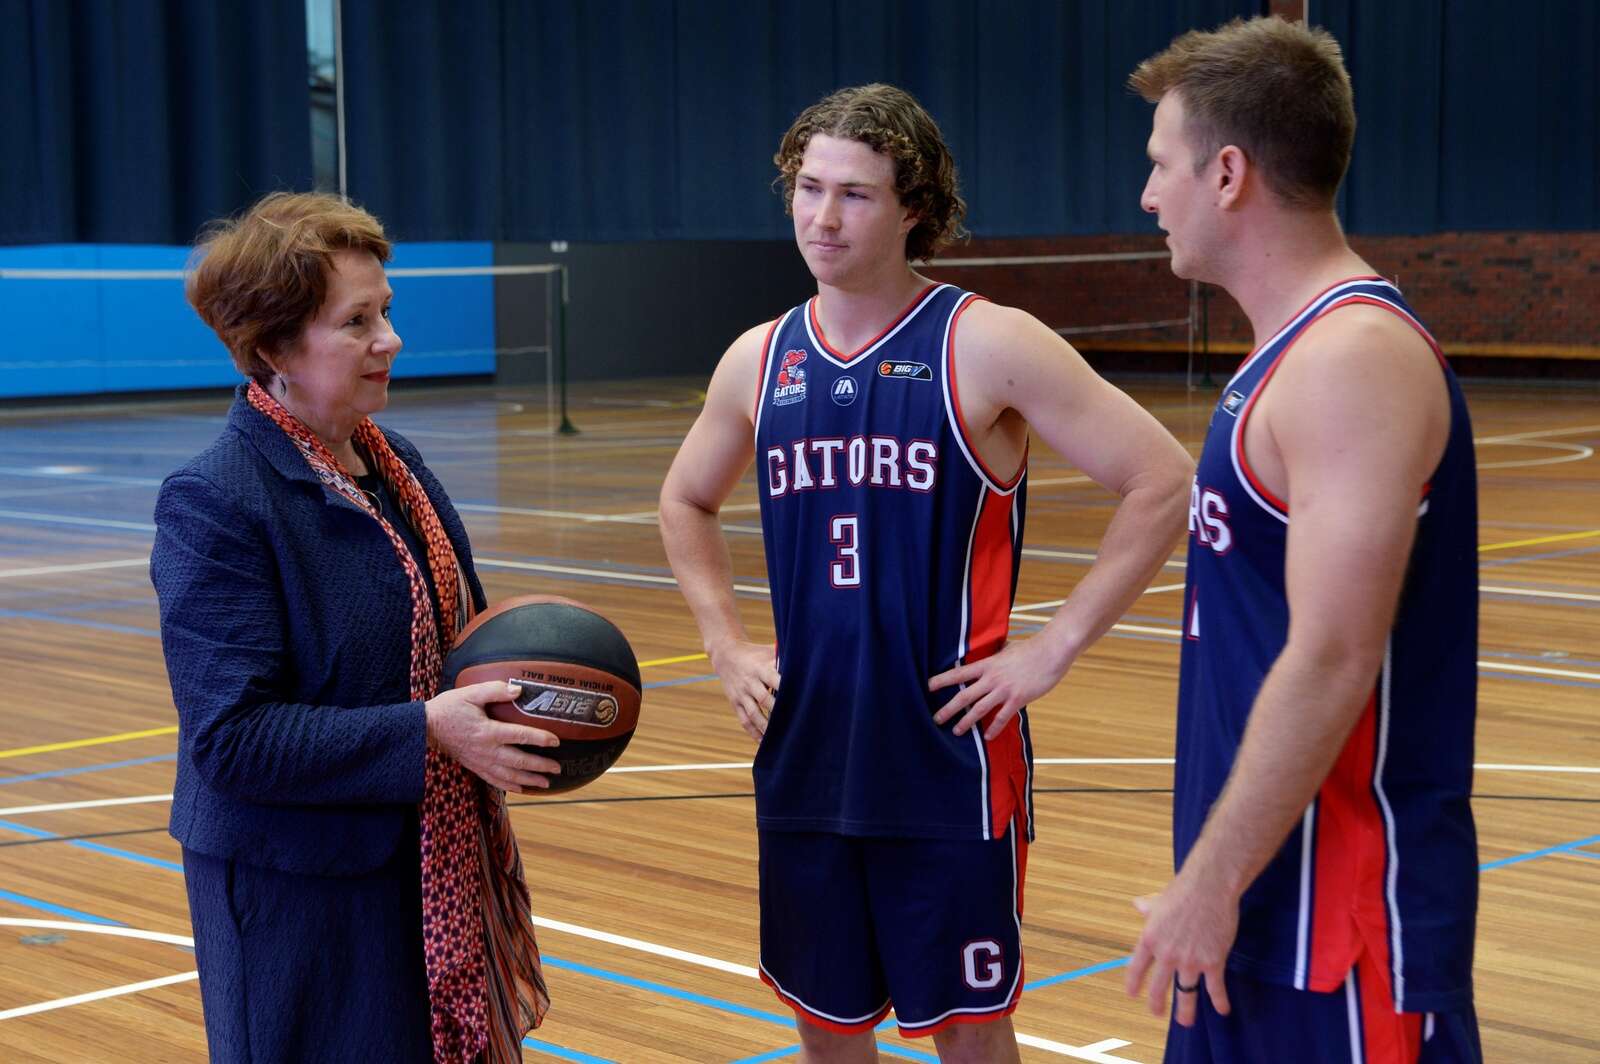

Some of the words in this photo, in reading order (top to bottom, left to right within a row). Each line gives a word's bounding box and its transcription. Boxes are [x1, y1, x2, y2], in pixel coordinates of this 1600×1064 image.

[774, 382, 807, 398] GATORS
[767, 434, 939, 499] GATORS
[829, 514, 861, 588] 3
[521, 669, 544, 681] BALL
[548, 674, 576, 685] GAME
[962, 939, 1003, 989] G
